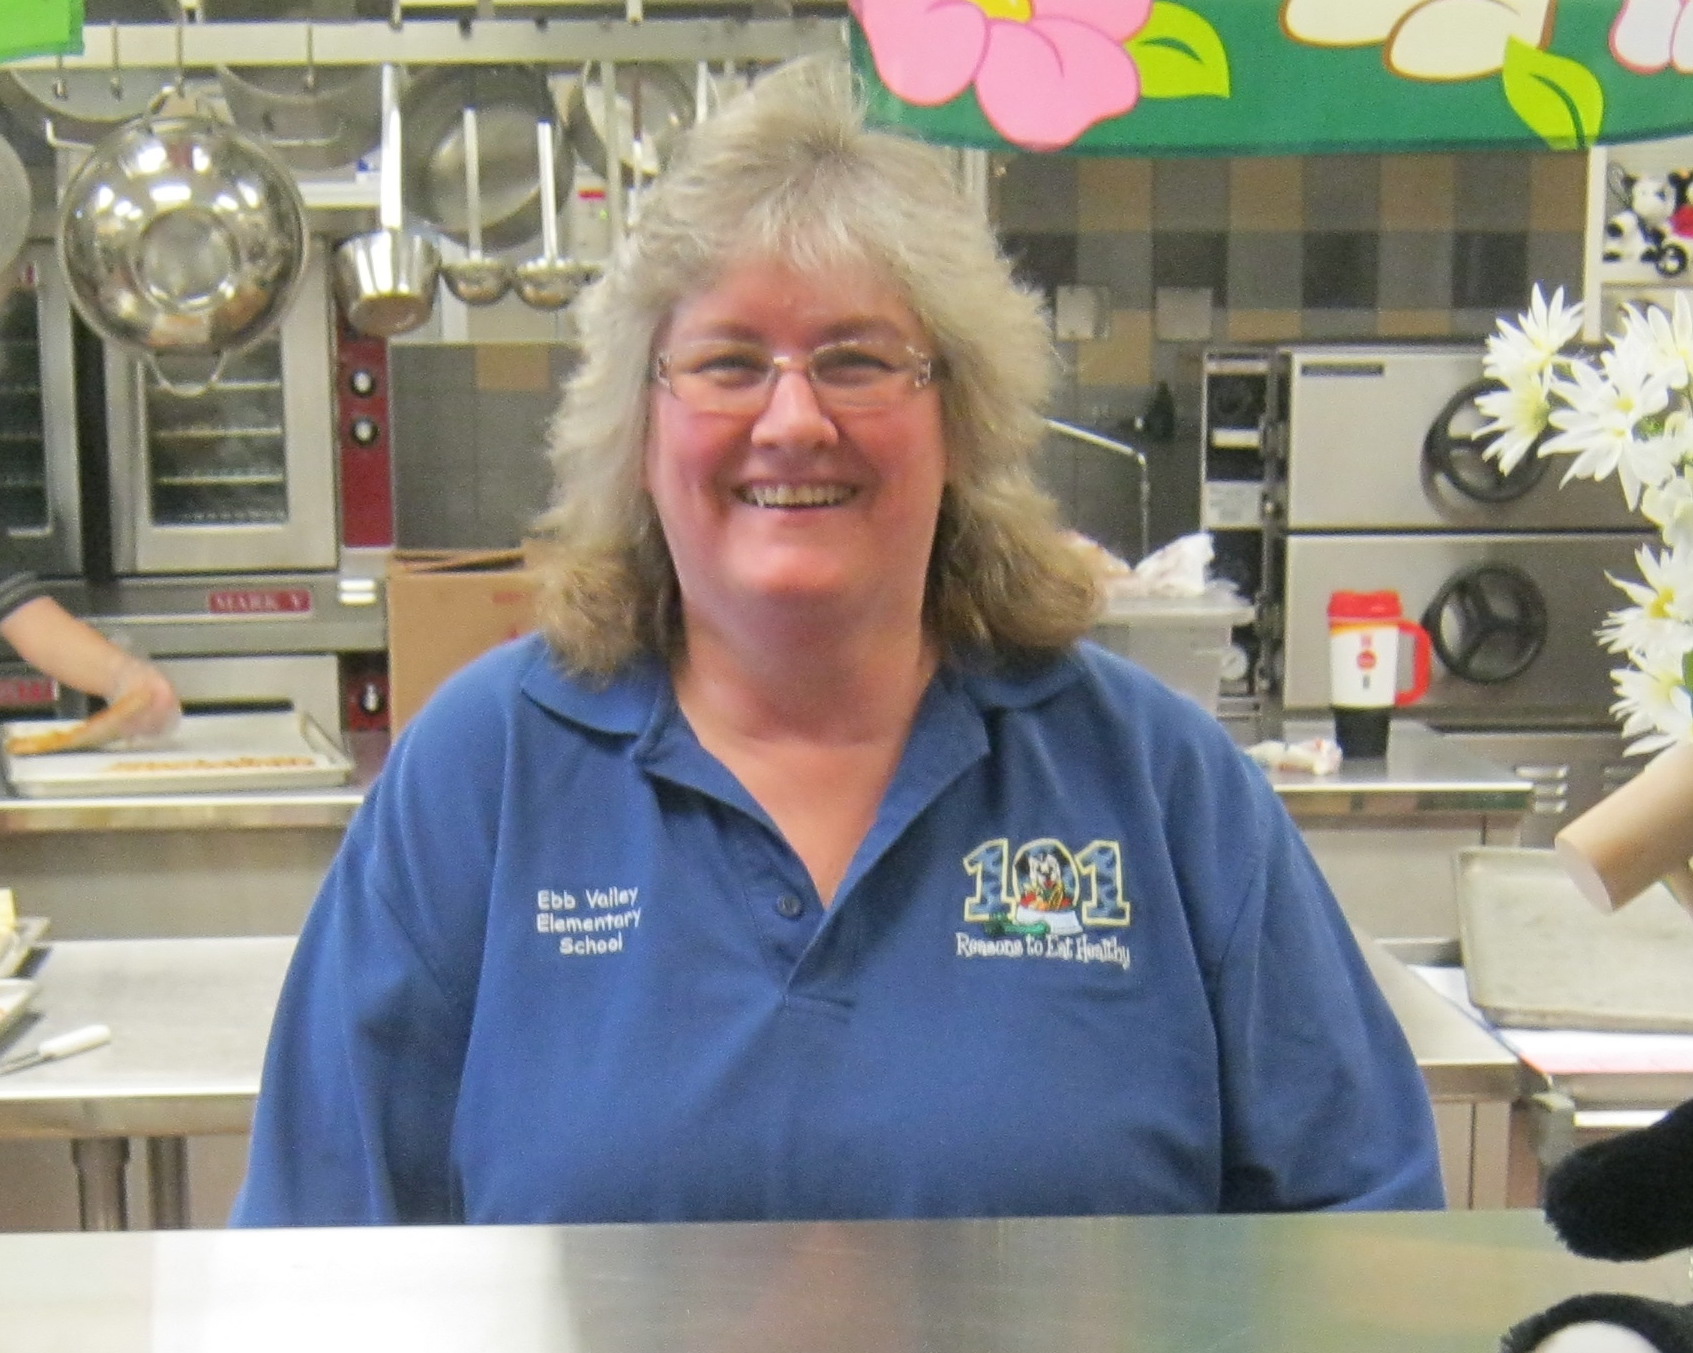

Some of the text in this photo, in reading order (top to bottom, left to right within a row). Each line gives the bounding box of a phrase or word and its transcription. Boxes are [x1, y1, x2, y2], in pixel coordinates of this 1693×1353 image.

[962, 837, 1130, 927] 101
[537, 886, 638, 910] Ebb Valley
[536, 907, 641, 933] Elementary
[559, 930, 623, 955] School
[955, 932, 1131, 970] Reasons to Eat Healthy
